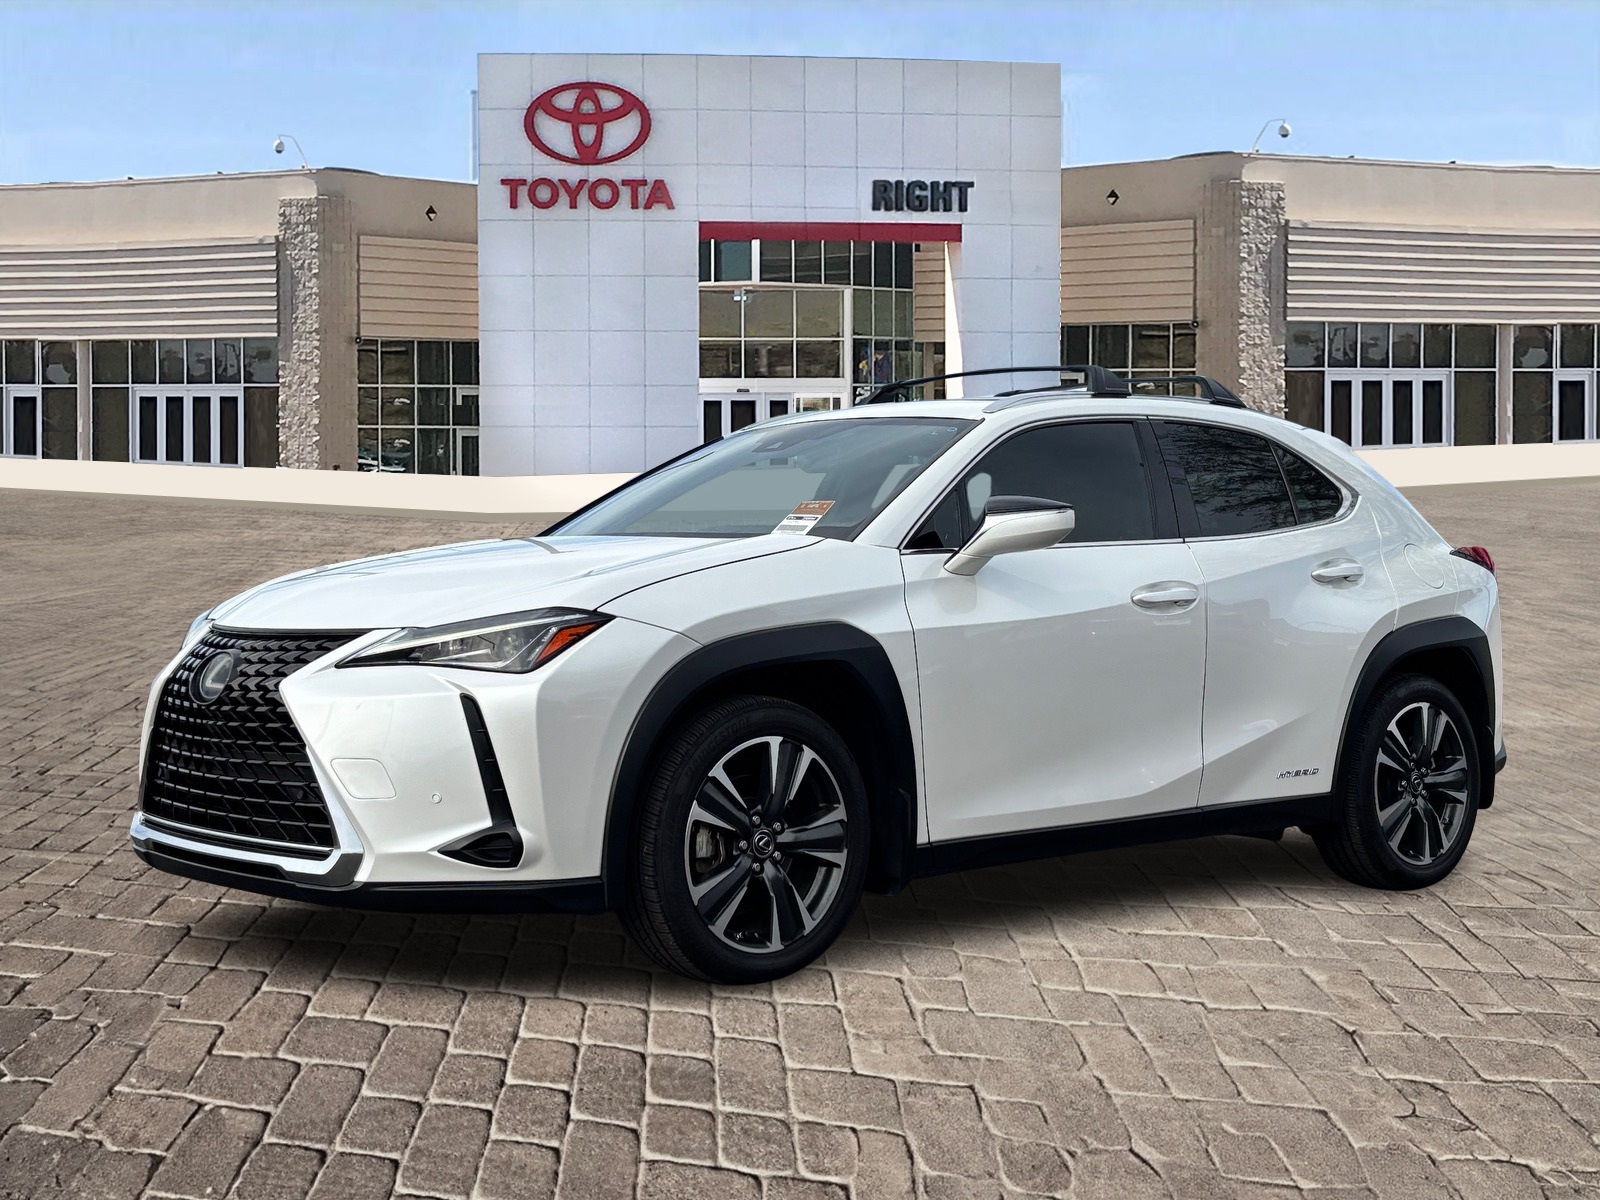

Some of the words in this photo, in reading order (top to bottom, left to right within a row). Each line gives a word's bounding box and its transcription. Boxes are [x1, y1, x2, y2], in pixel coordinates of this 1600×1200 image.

[500, 178, 676, 210] TOYOTA
[872, 180, 975, 212] RIGHT
[1276, 768, 1320, 780] HYBRID
